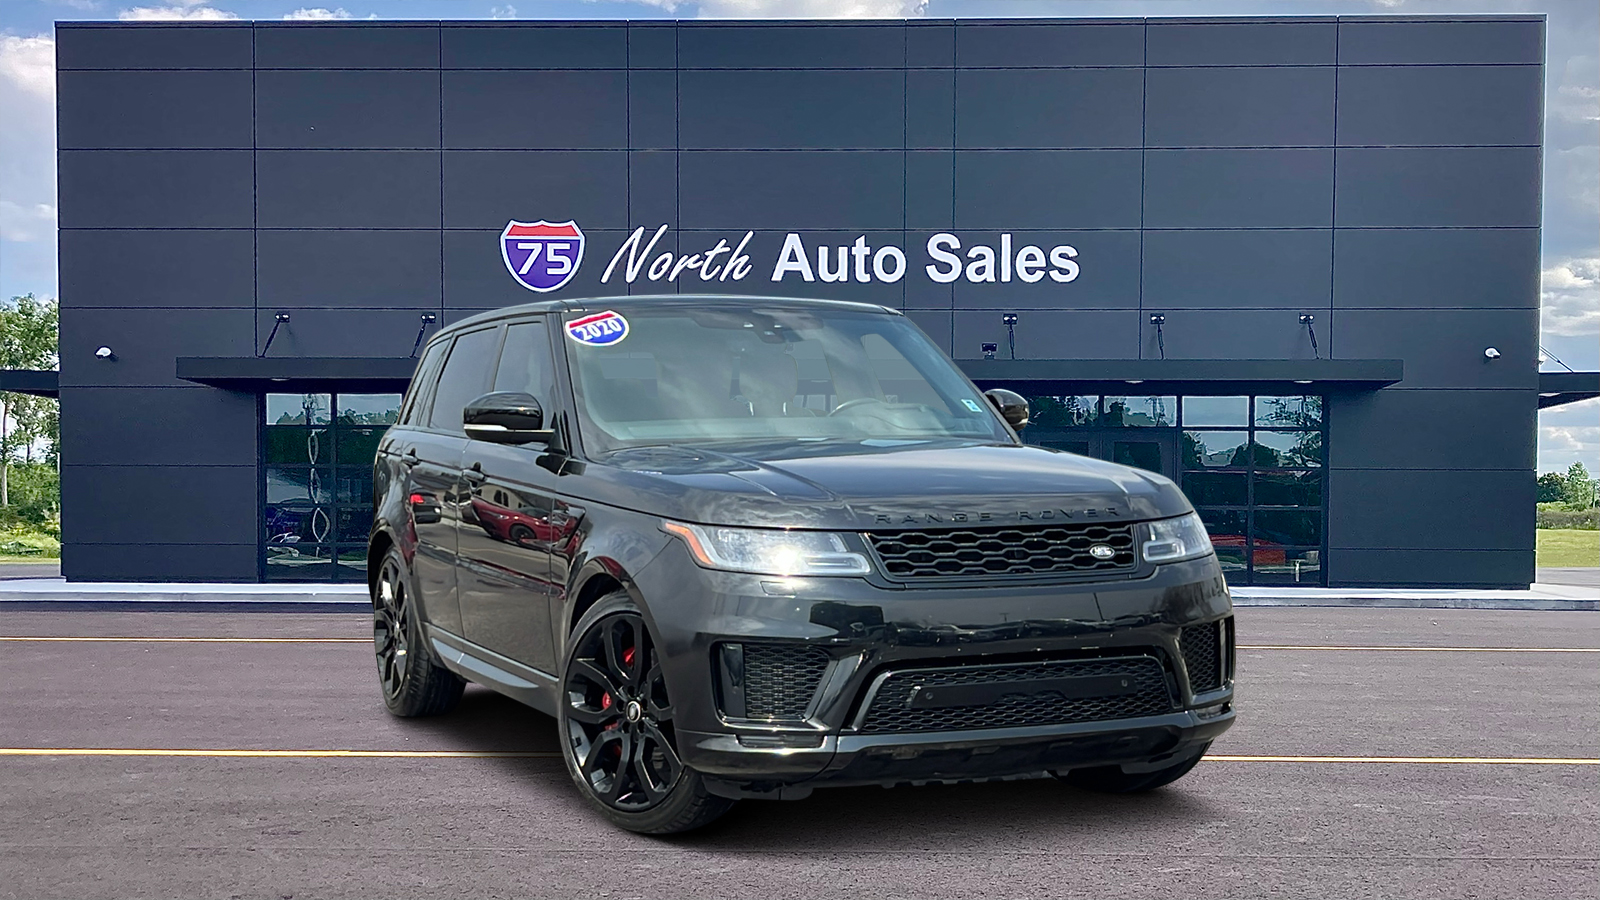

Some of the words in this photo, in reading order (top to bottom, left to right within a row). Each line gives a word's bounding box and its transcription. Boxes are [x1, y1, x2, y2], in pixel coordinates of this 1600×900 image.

[516, 242, 572, 276] 75
[600, 223, 753, 284] North
[771, 233, 907, 283] Auto
[925, 232, 1080, 284] Sales
[575, 319, 622, 341] 2020
[874, 512, 993, 525] RANGE
[1015, 507, 1120, 520] ROVER
